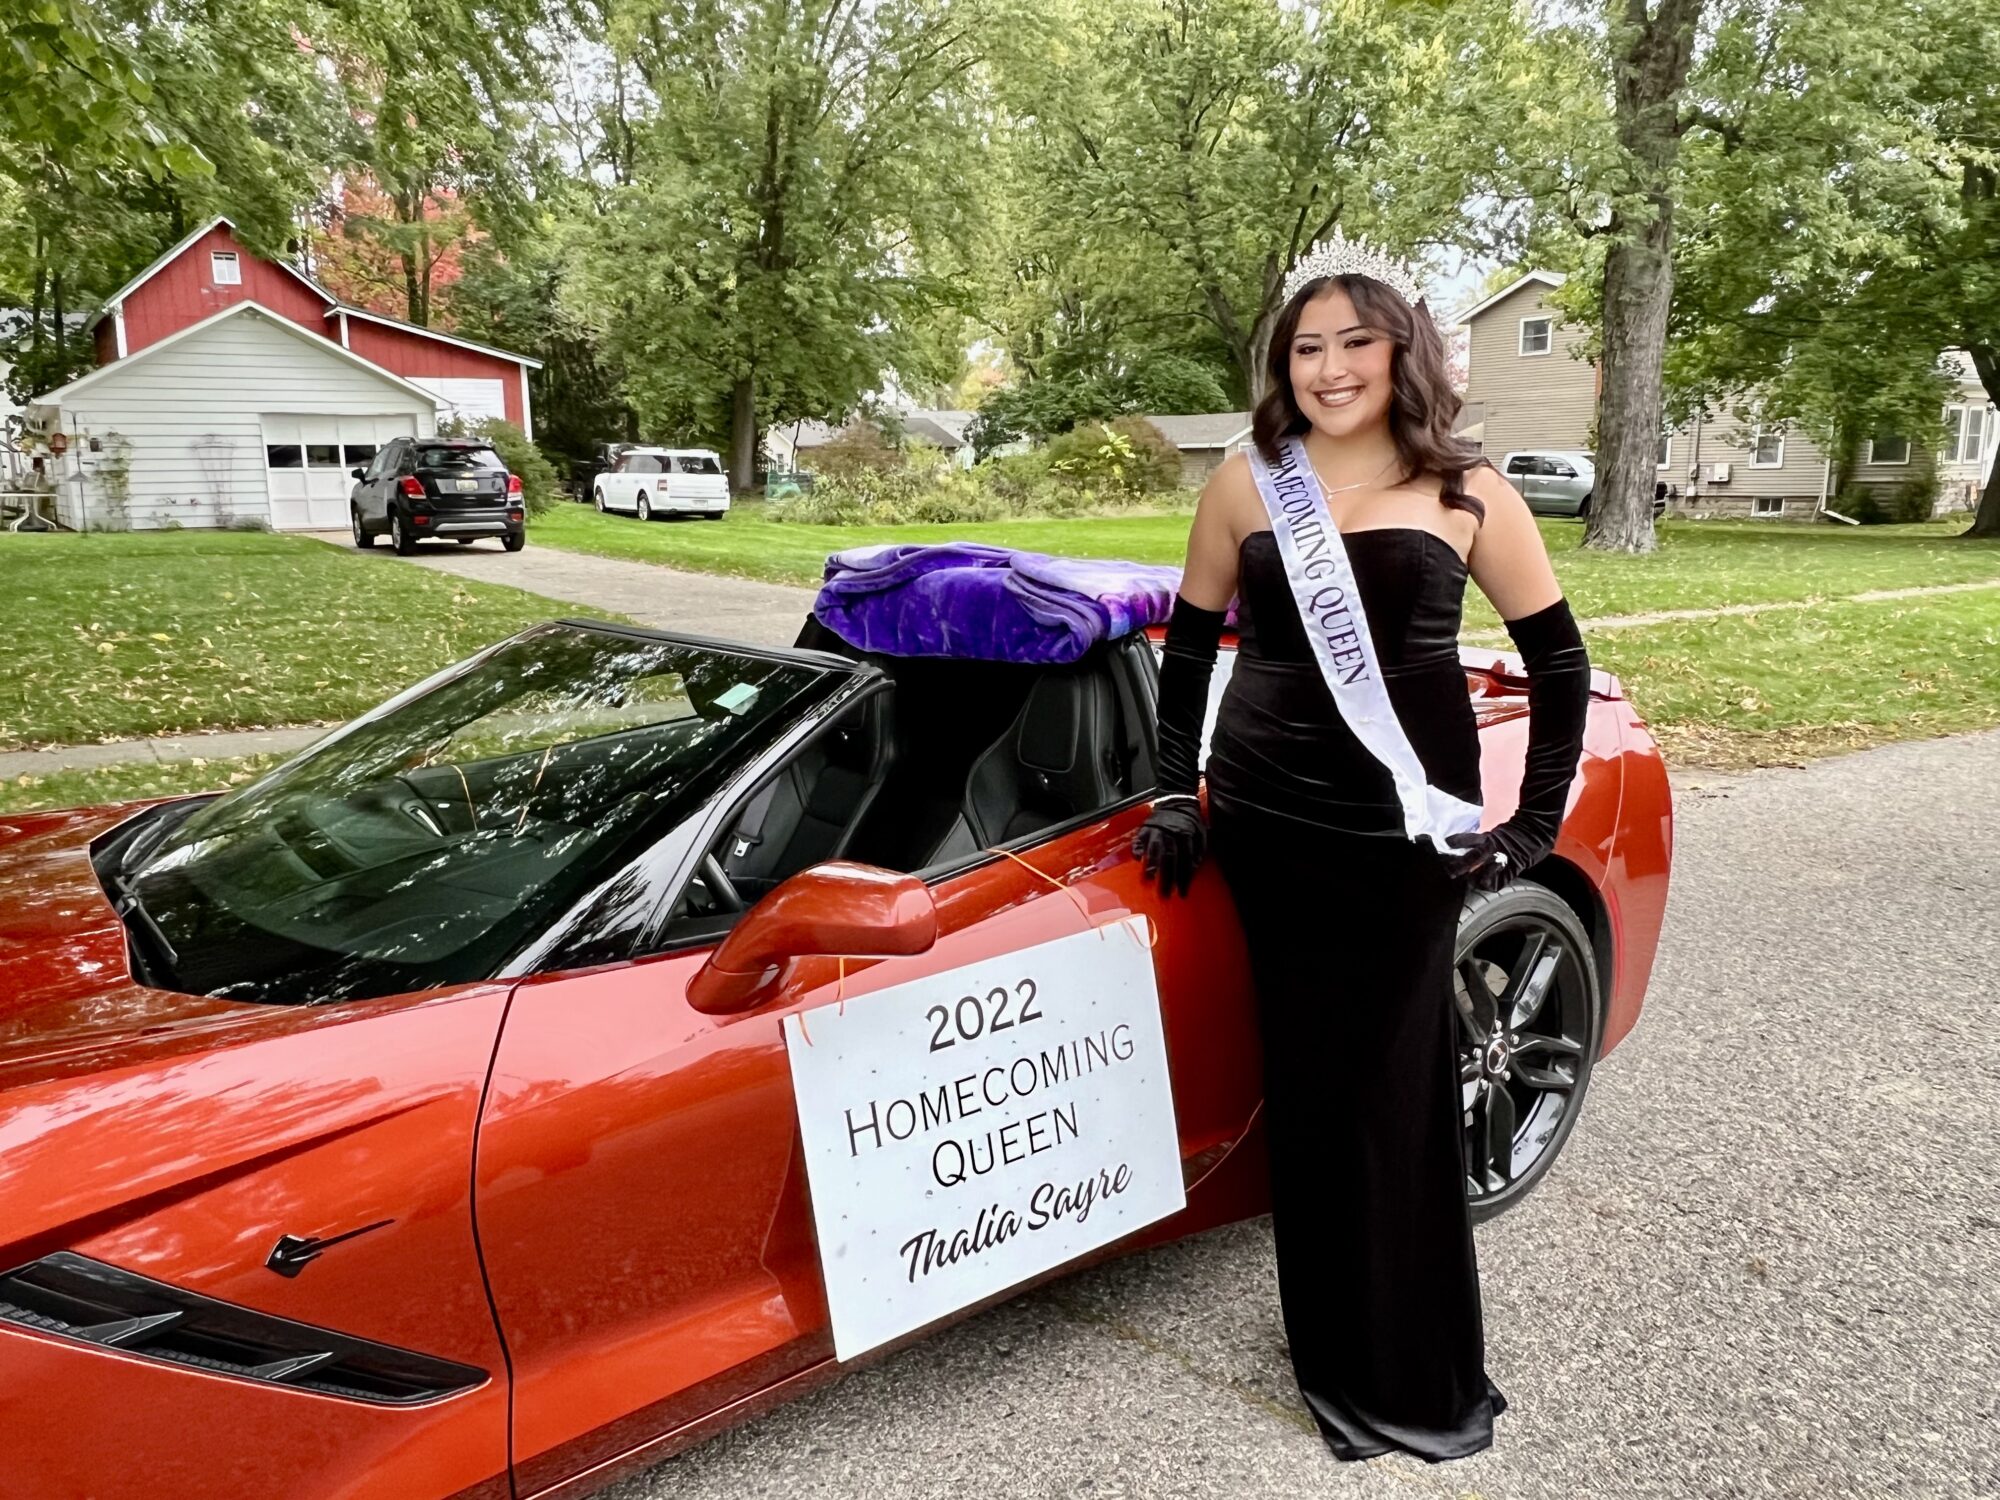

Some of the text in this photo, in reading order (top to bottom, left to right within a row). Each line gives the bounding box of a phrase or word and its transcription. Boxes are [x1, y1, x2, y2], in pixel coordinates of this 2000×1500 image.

[1306, 586, 1370, 686] QUEEN
[925, 978, 1042, 1053] 2022
[843, 1023, 1135, 1157] HOMECOMING
[932, 1102, 1079, 1188] QUEEN
[900, 1162, 1133, 1283] Thalia Sayre
